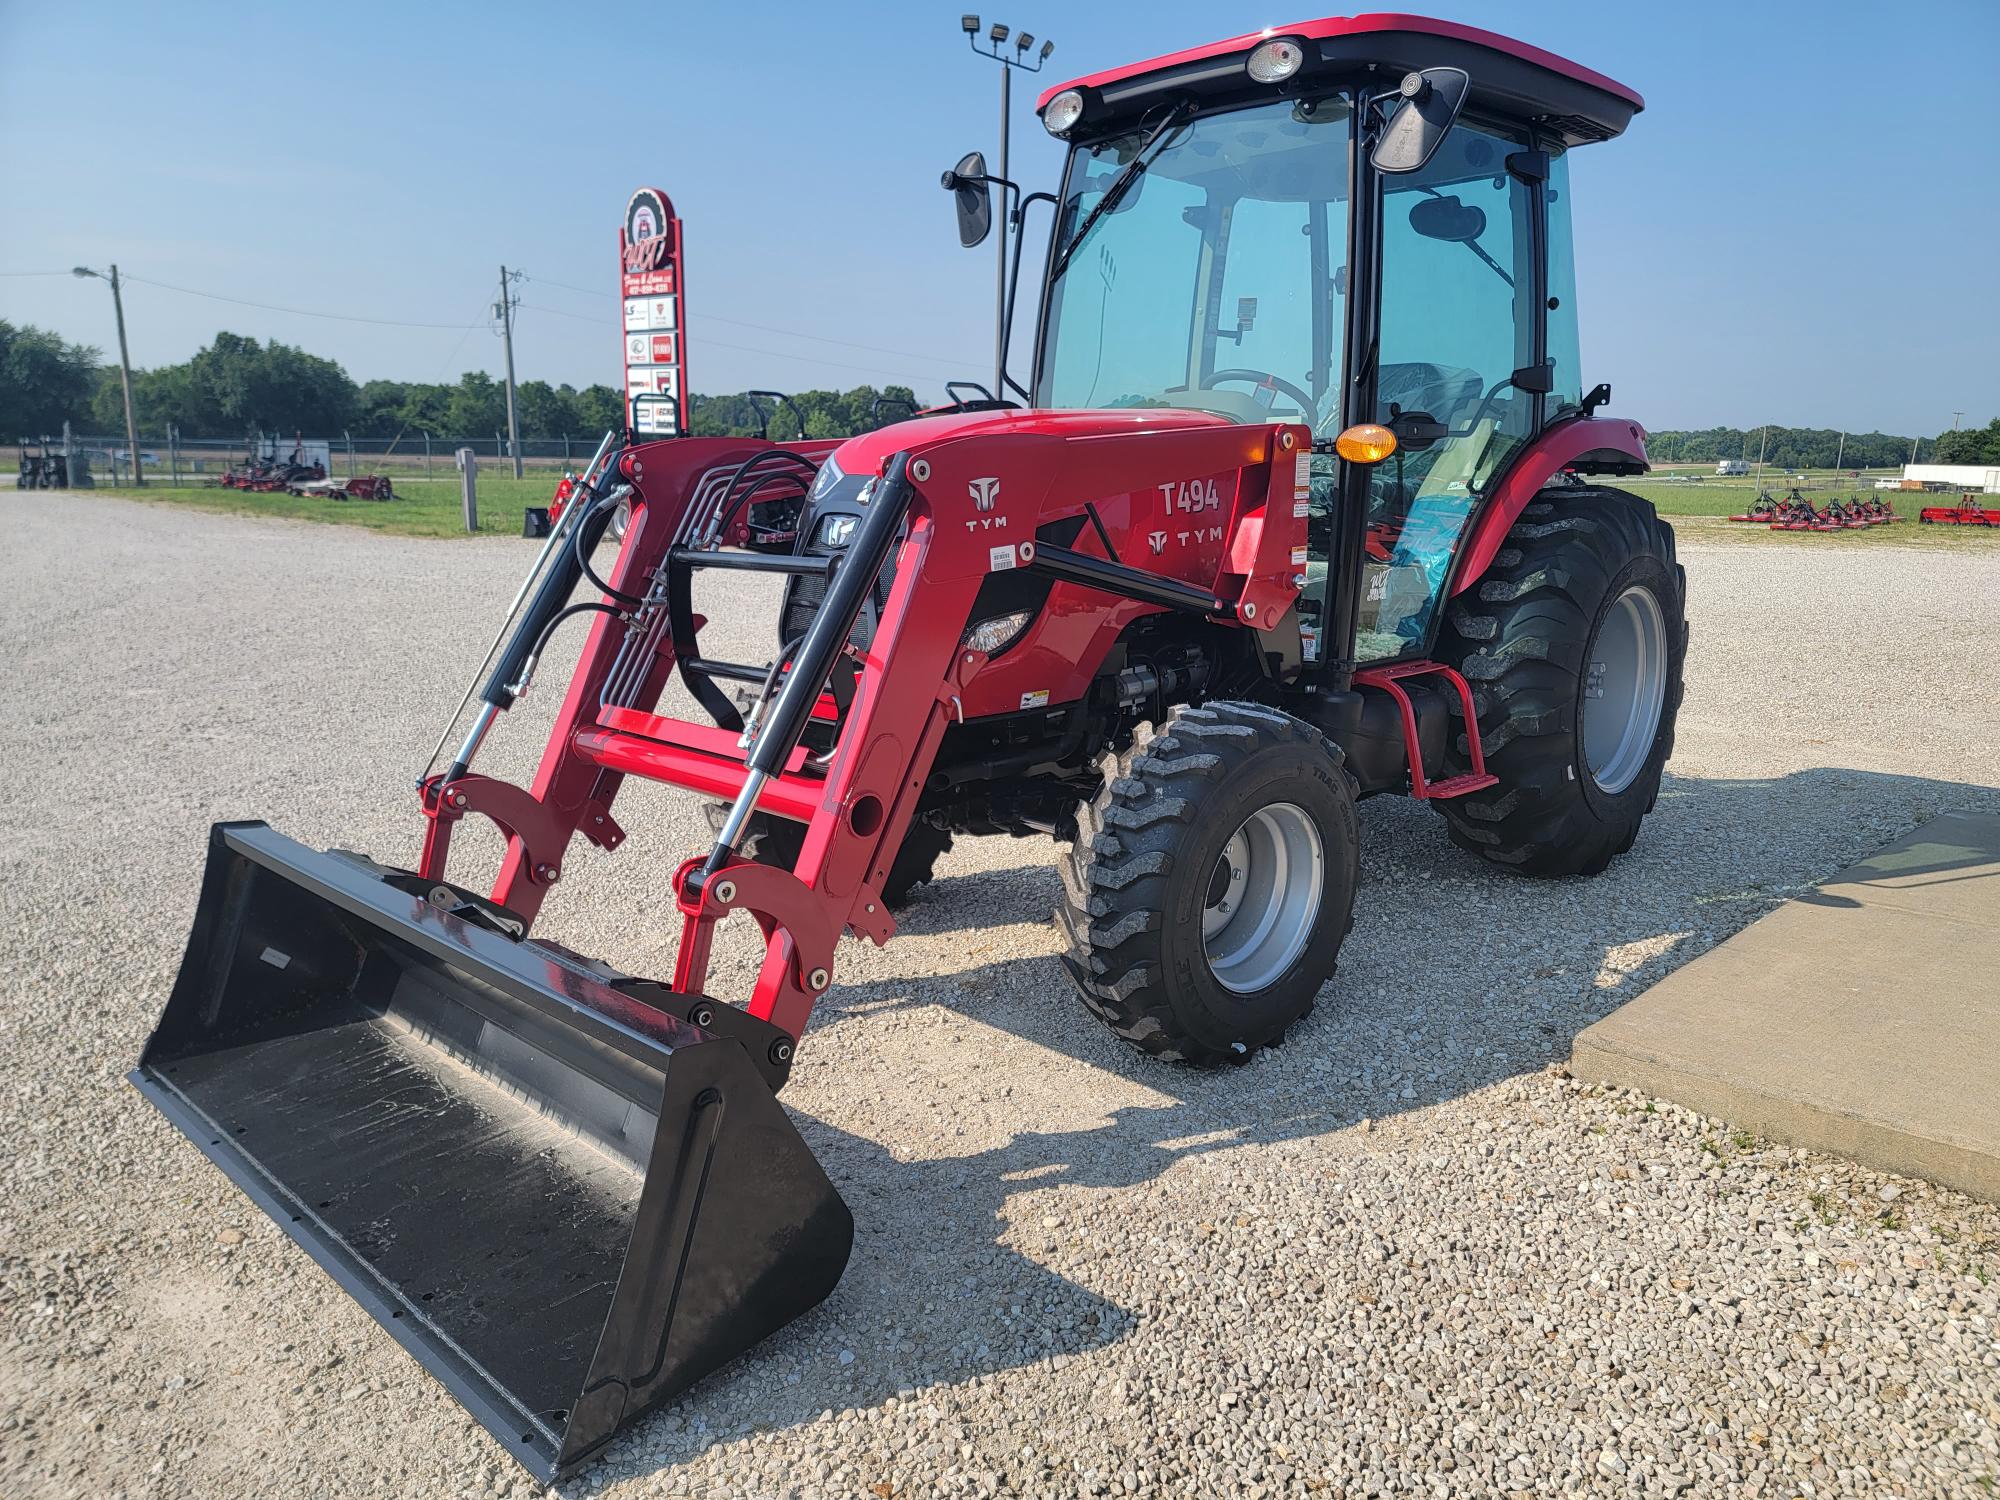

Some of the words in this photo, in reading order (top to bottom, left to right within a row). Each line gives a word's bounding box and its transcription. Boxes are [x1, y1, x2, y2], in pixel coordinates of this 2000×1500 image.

[1158, 479, 1219, 515] T494
[966, 516, 1007, 532] TYM
[1177, 526, 1223, 547] TYM
[1312, 766, 1339, 795] TRAC
